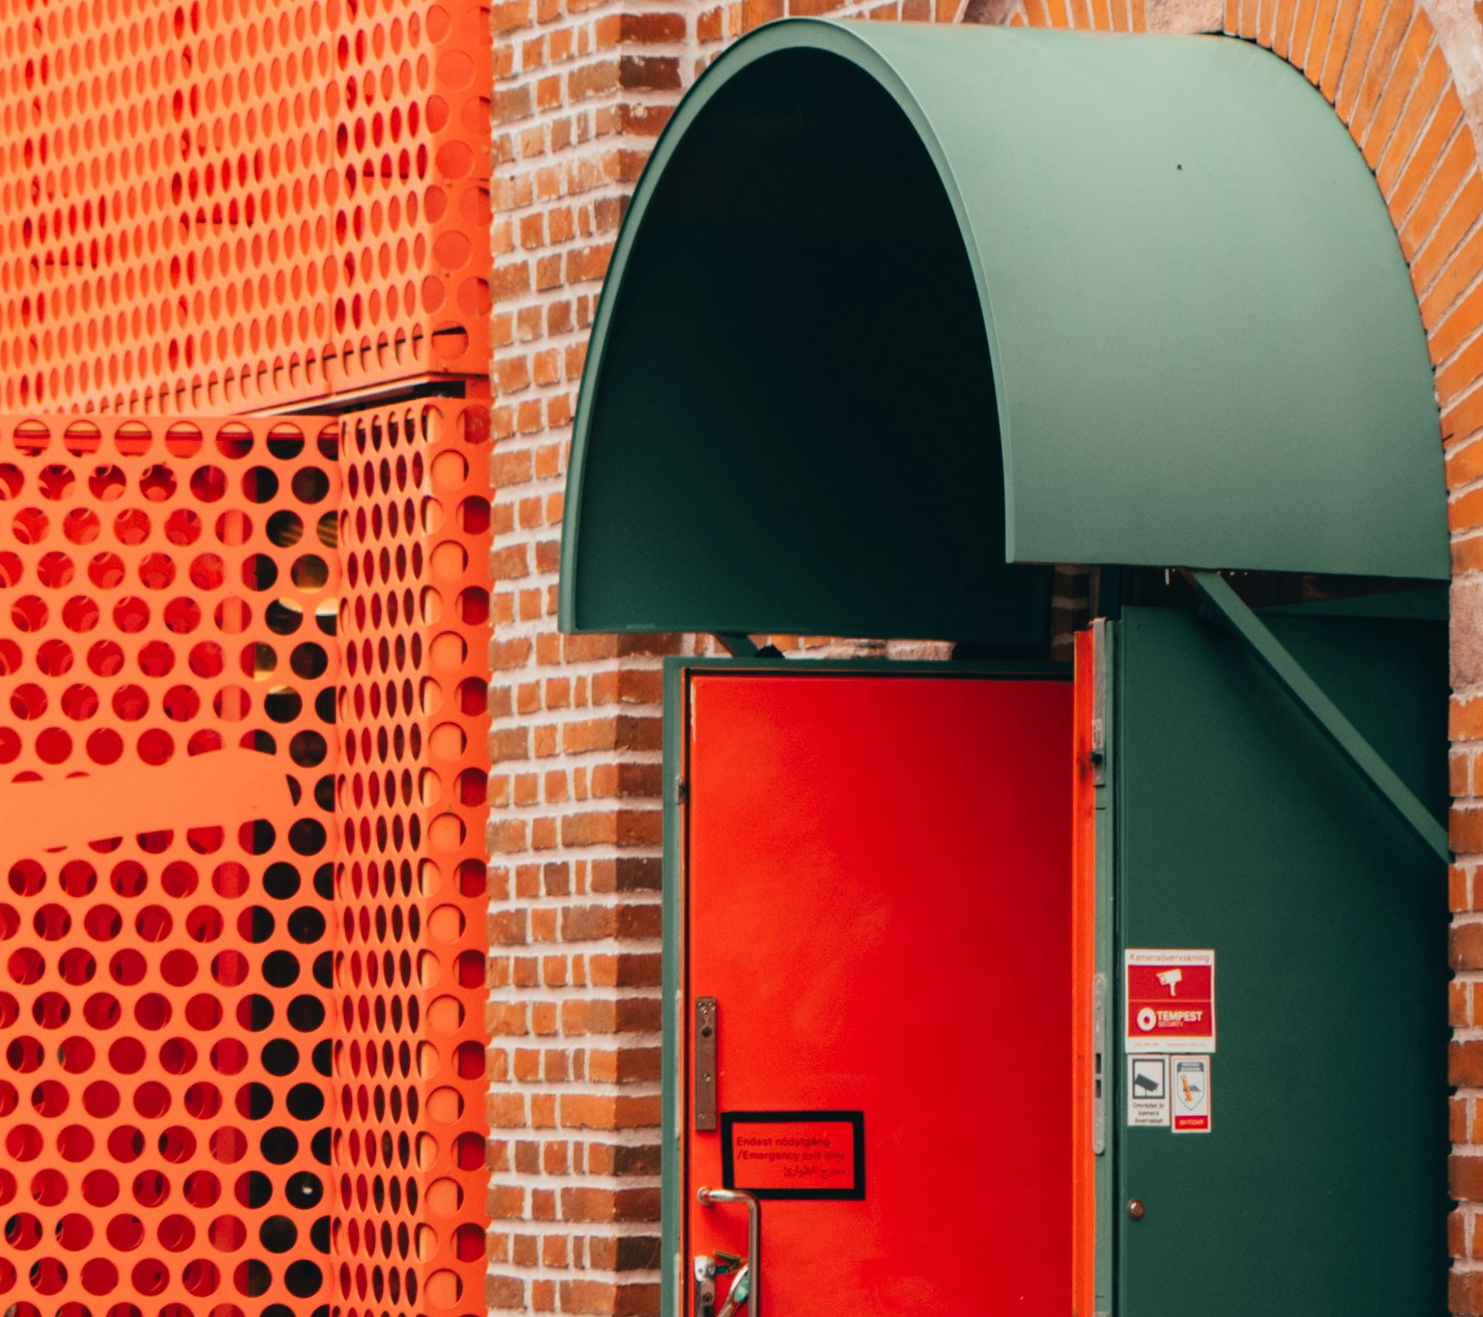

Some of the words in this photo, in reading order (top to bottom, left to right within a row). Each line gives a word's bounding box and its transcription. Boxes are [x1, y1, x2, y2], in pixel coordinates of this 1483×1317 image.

[1129, 953, 1210, 964] Kameraövervakning
[1156, 1010, 1203, 1022] TEMPEST
[736, 1136, 772, 1147] Endast
[775, 1136, 831, 1149] nödutgång
[736, 1150, 799, 1162] /Emergency
[802, 1151, 821, 1160] exit
